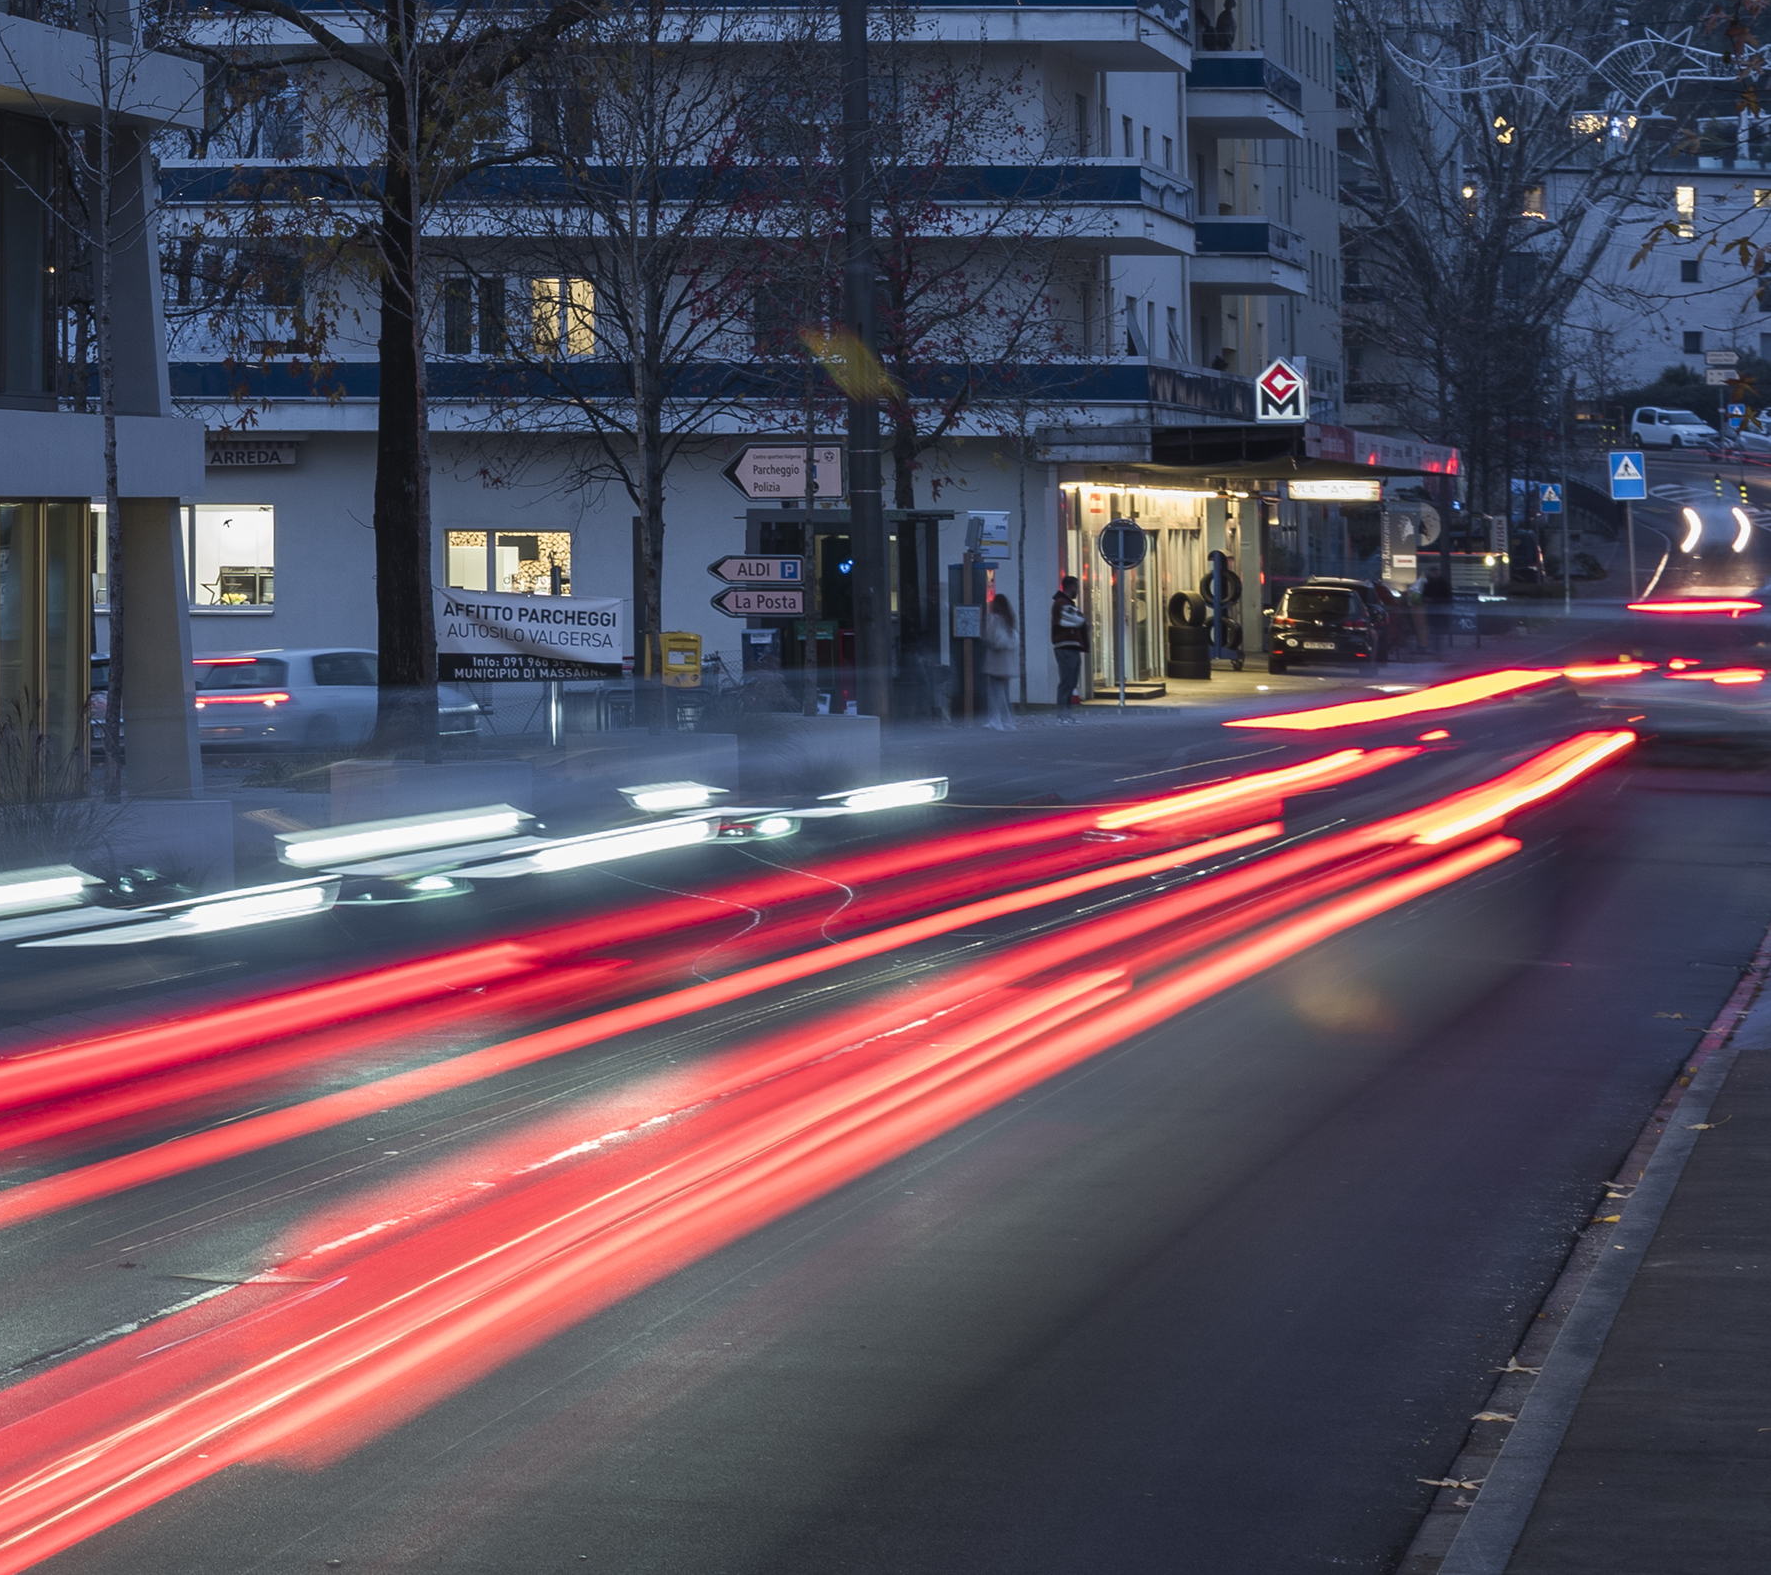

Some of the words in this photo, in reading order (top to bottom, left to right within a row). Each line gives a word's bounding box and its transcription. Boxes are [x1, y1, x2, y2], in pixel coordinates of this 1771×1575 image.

[210, 450, 282, 465] ARREDA
[753, 464, 800, 477] Parcheggio
[753, 482, 780, 492] Polizia
[737, 563, 770, 576] ALDI
[735, 594, 751, 609] La
[757, 594, 796, 609] Posta
[443, 602, 513, 621] AFFITTO
[518, 607, 616, 627] PARCHEGGI
[447, 623, 524, 642] AUTOSILO
[528, 629, 613, 648] VALGERSA
[473, 657, 500, 667] Info:
[503, 657, 523, 667] 091
[528, 657, 548, 668] 960
[454, 668, 519, 679] MUNICIPIO
[523, 668, 536, 679] DI
